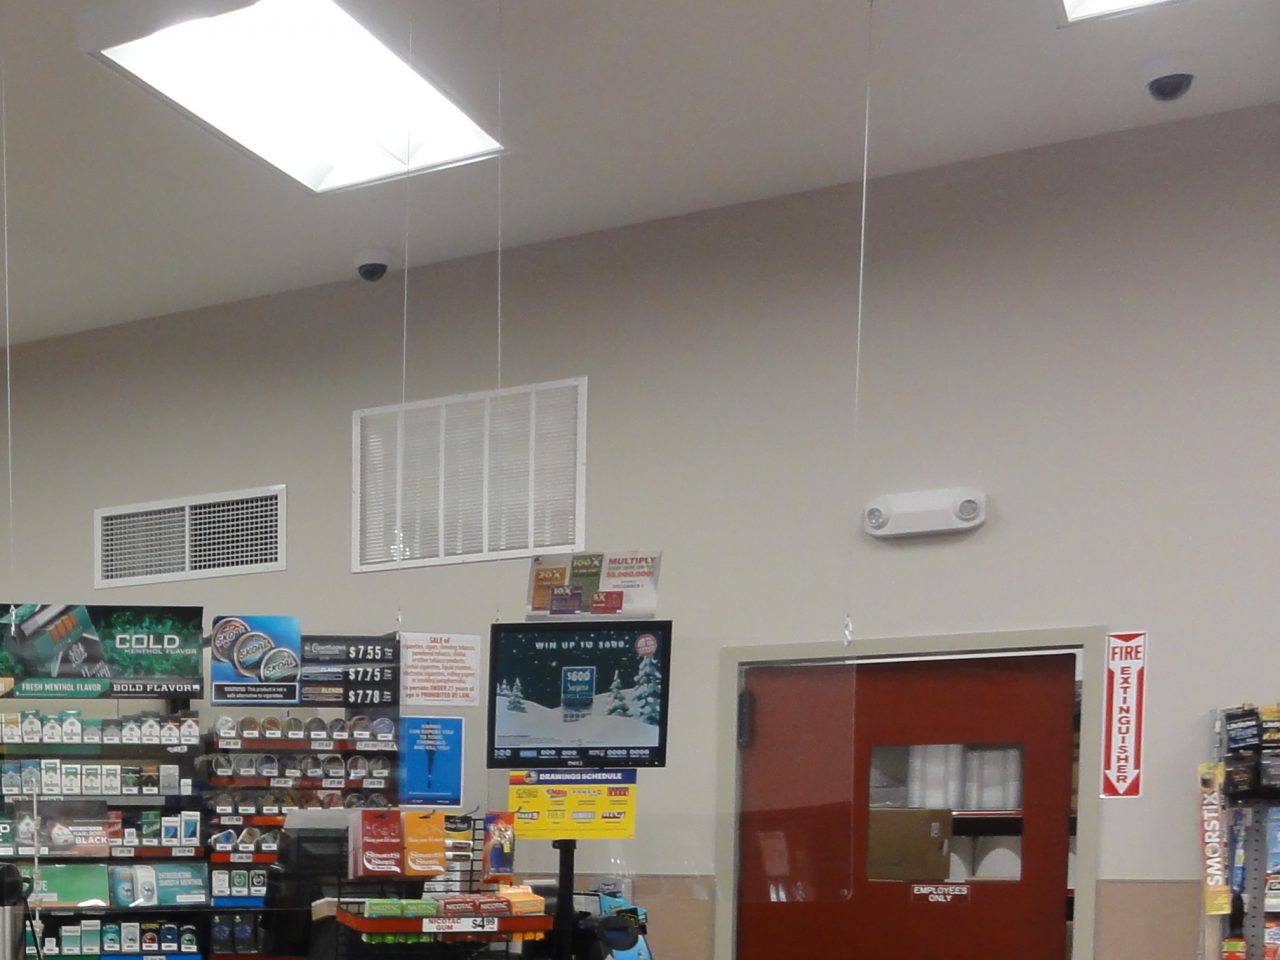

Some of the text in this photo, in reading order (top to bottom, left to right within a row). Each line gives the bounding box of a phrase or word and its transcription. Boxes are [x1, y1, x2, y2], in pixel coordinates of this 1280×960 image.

[608, 556, 656, 565] MULTIPLY
[239, 639, 270, 660] SKOAL
[1111, 645, 1142, 661] FIRE
[265, 657, 296, 675] SKOAL
[567, 671, 590, 681] $600
[22, 683, 101, 692] FRESH MENTHOL FLAVOR
[113, 684, 192, 692] BOLD FLAVOR
[1115, 666, 1132, 784] EXTINGUISHER
[75, 836, 108, 844] BLACK
[913, 886, 968, 895] EMPLOYEES
[929, 894, 952, 902] ONLY
[446, 903, 473, 911] NICOTAC
[480, 902, 508, 910] NICOTAC
